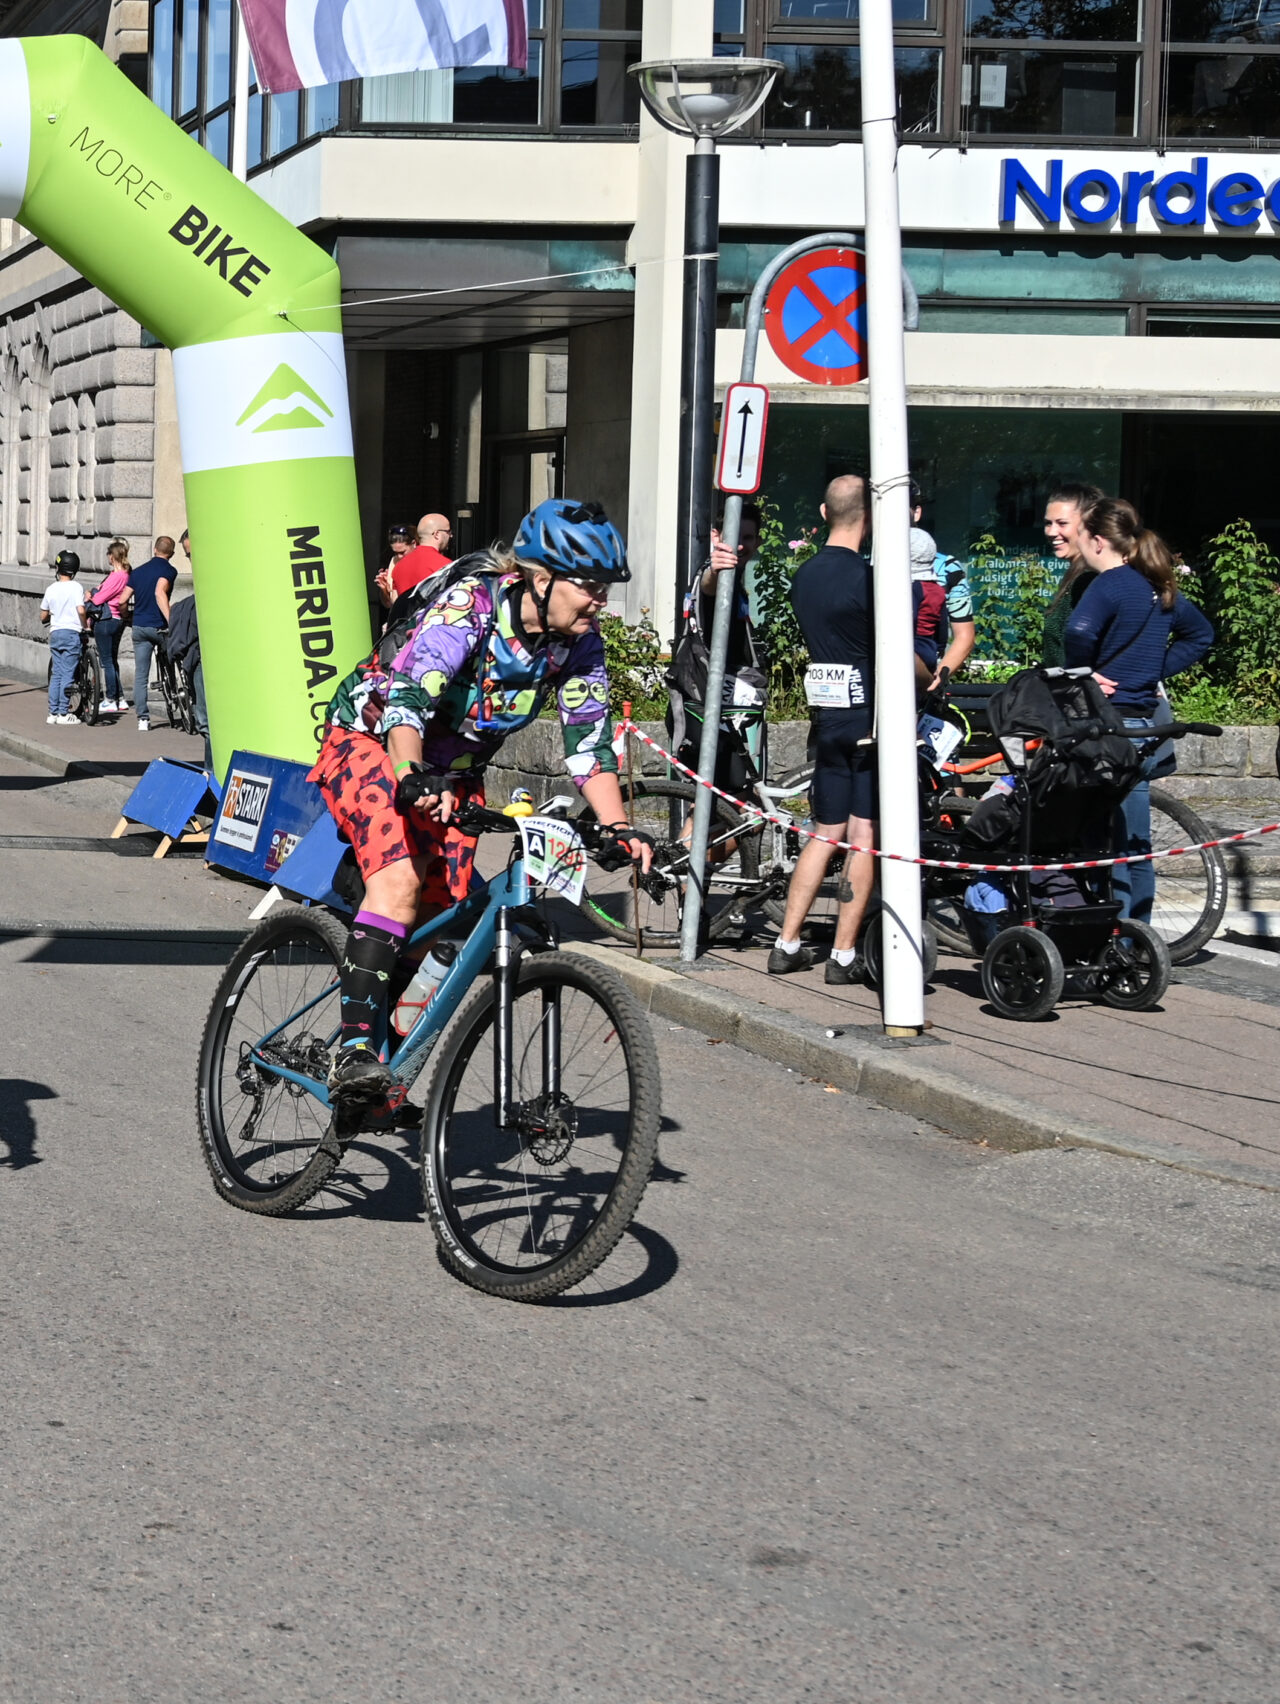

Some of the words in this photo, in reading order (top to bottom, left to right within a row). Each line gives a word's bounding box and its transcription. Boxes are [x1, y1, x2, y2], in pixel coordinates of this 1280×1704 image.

[998, 156, 1280, 227] Norde
[167, 205, 271, 298] BIKE
[1048, 558, 1072, 570] give
[808, 668, 823, 680] 103
[826, 669, 845, 681] KM
[234, 782, 267, 821] STARK
[529, 835, 545, 856] A
[199, 1087, 213, 1147] ROCKET
[423, 1152, 442, 1216] ROCKET
